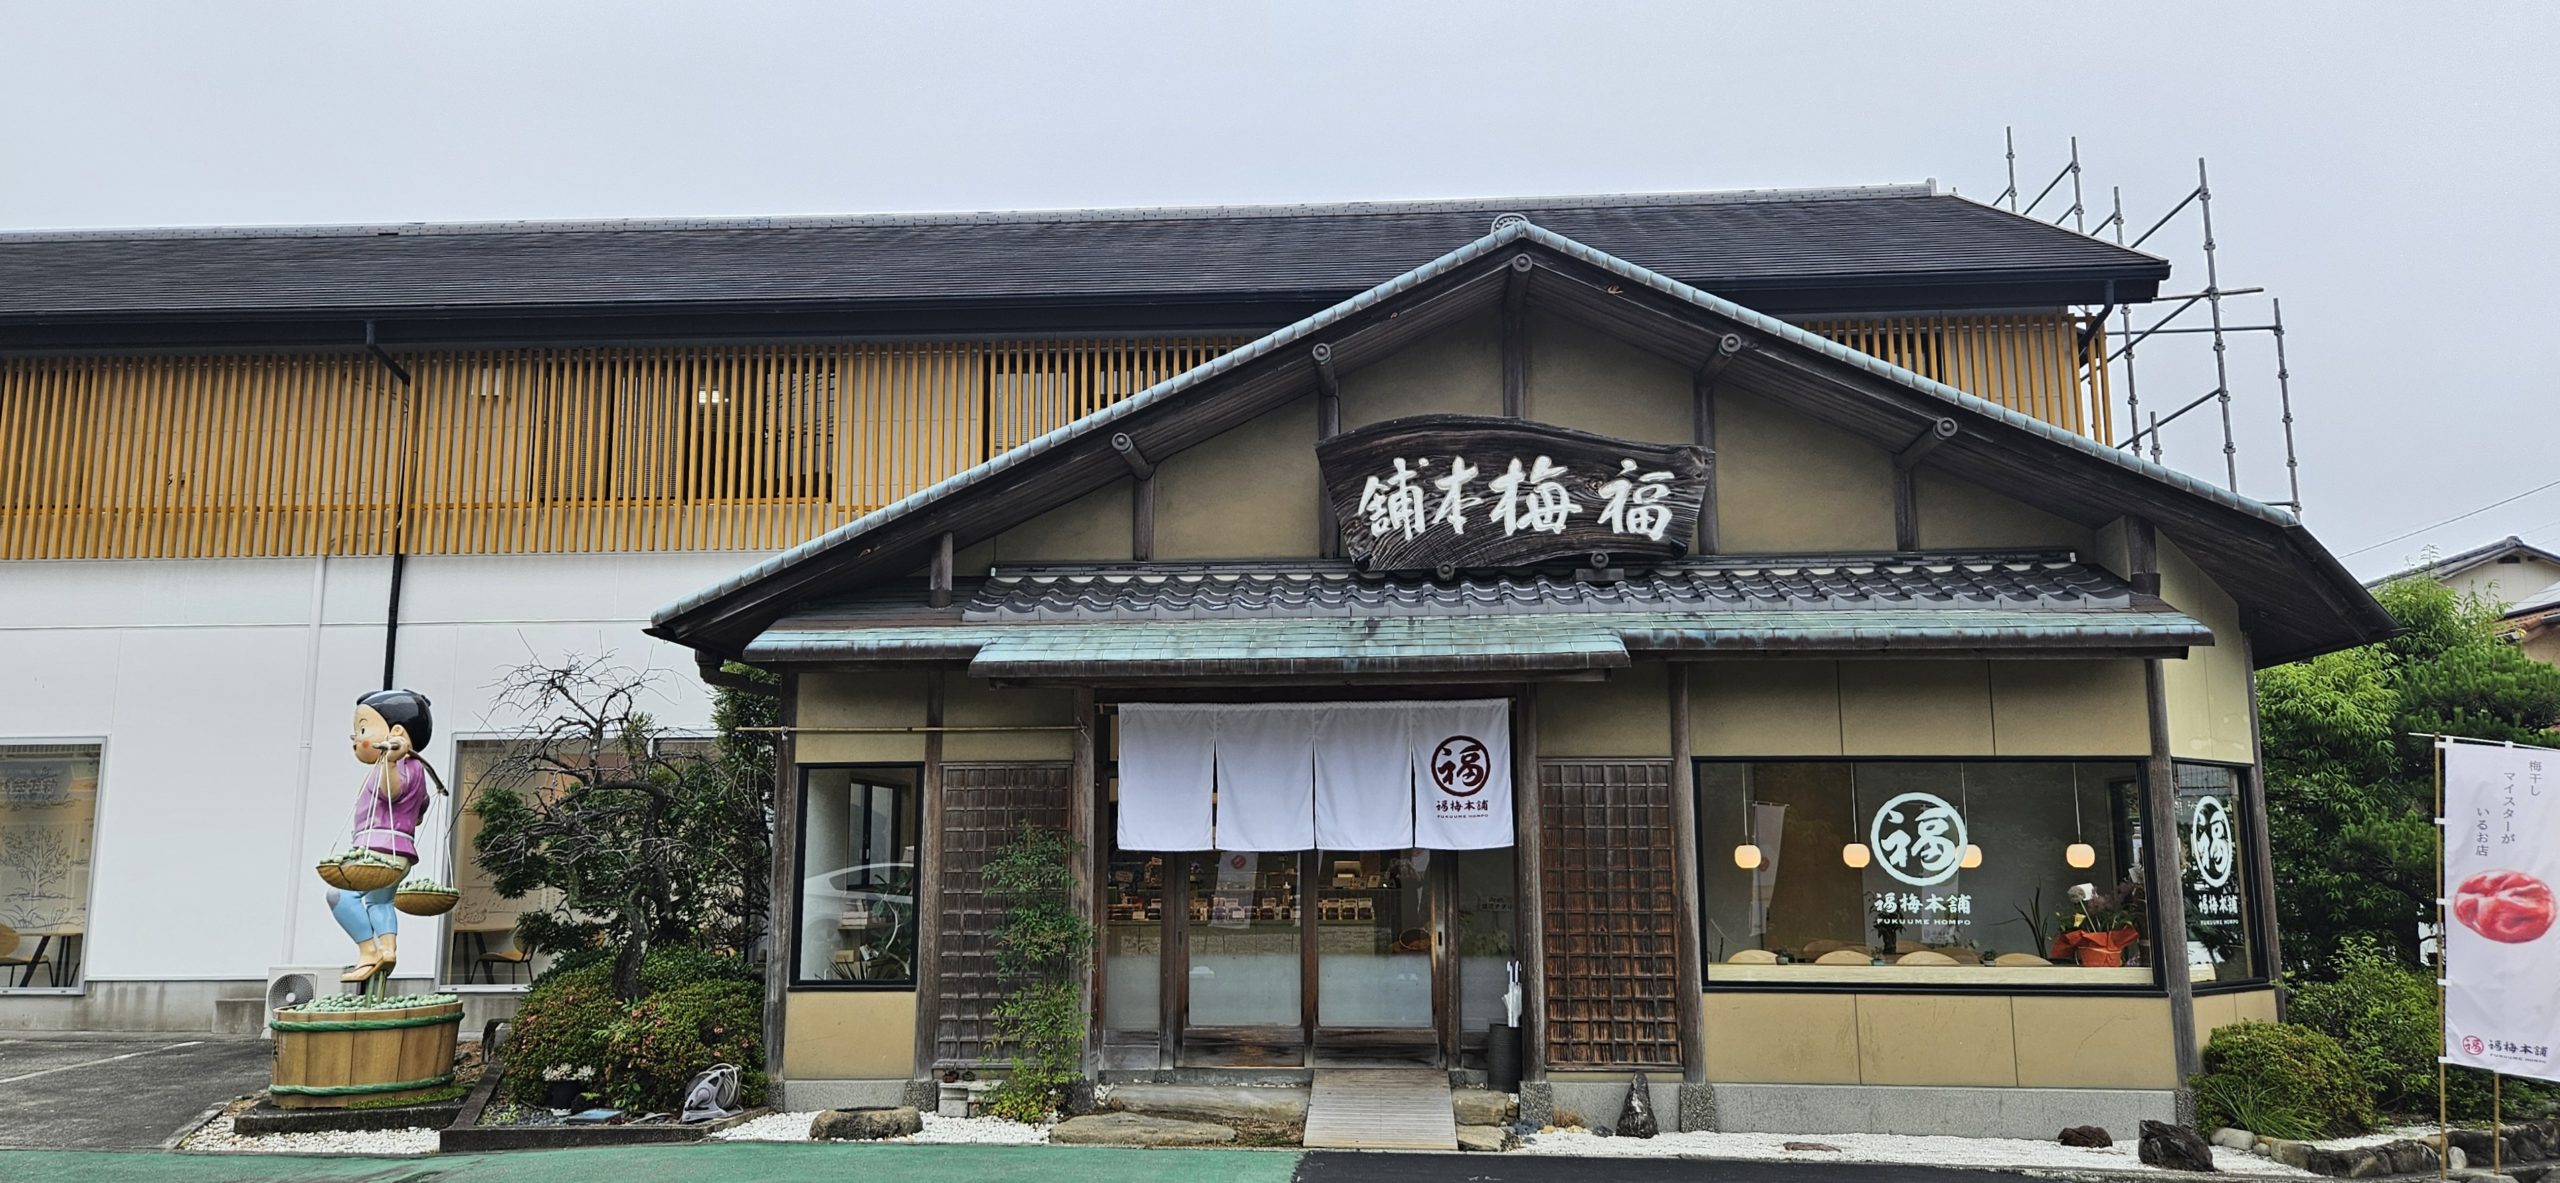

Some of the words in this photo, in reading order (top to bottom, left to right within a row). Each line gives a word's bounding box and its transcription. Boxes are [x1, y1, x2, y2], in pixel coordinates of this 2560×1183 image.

[1435, 742, 1486, 788] 福
[2528, 760, 2543, 797] 梅干し
[2501, 772, 2516, 845] マイスターが
[1877, 802, 1961, 875] 福
[2196, 806, 2231, 877] 福
[2475, 807, 2490, 857] いるお店
[1874, 892, 1972, 915] 福梅本舗
[1876, 918, 1930, 926] FUKUUME
[1934, 918, 1972, 926] HOMPO
[2463, 1037, 2483, 1054] 福
[2487, 1039, 2549, 1058] 福梅本舗
